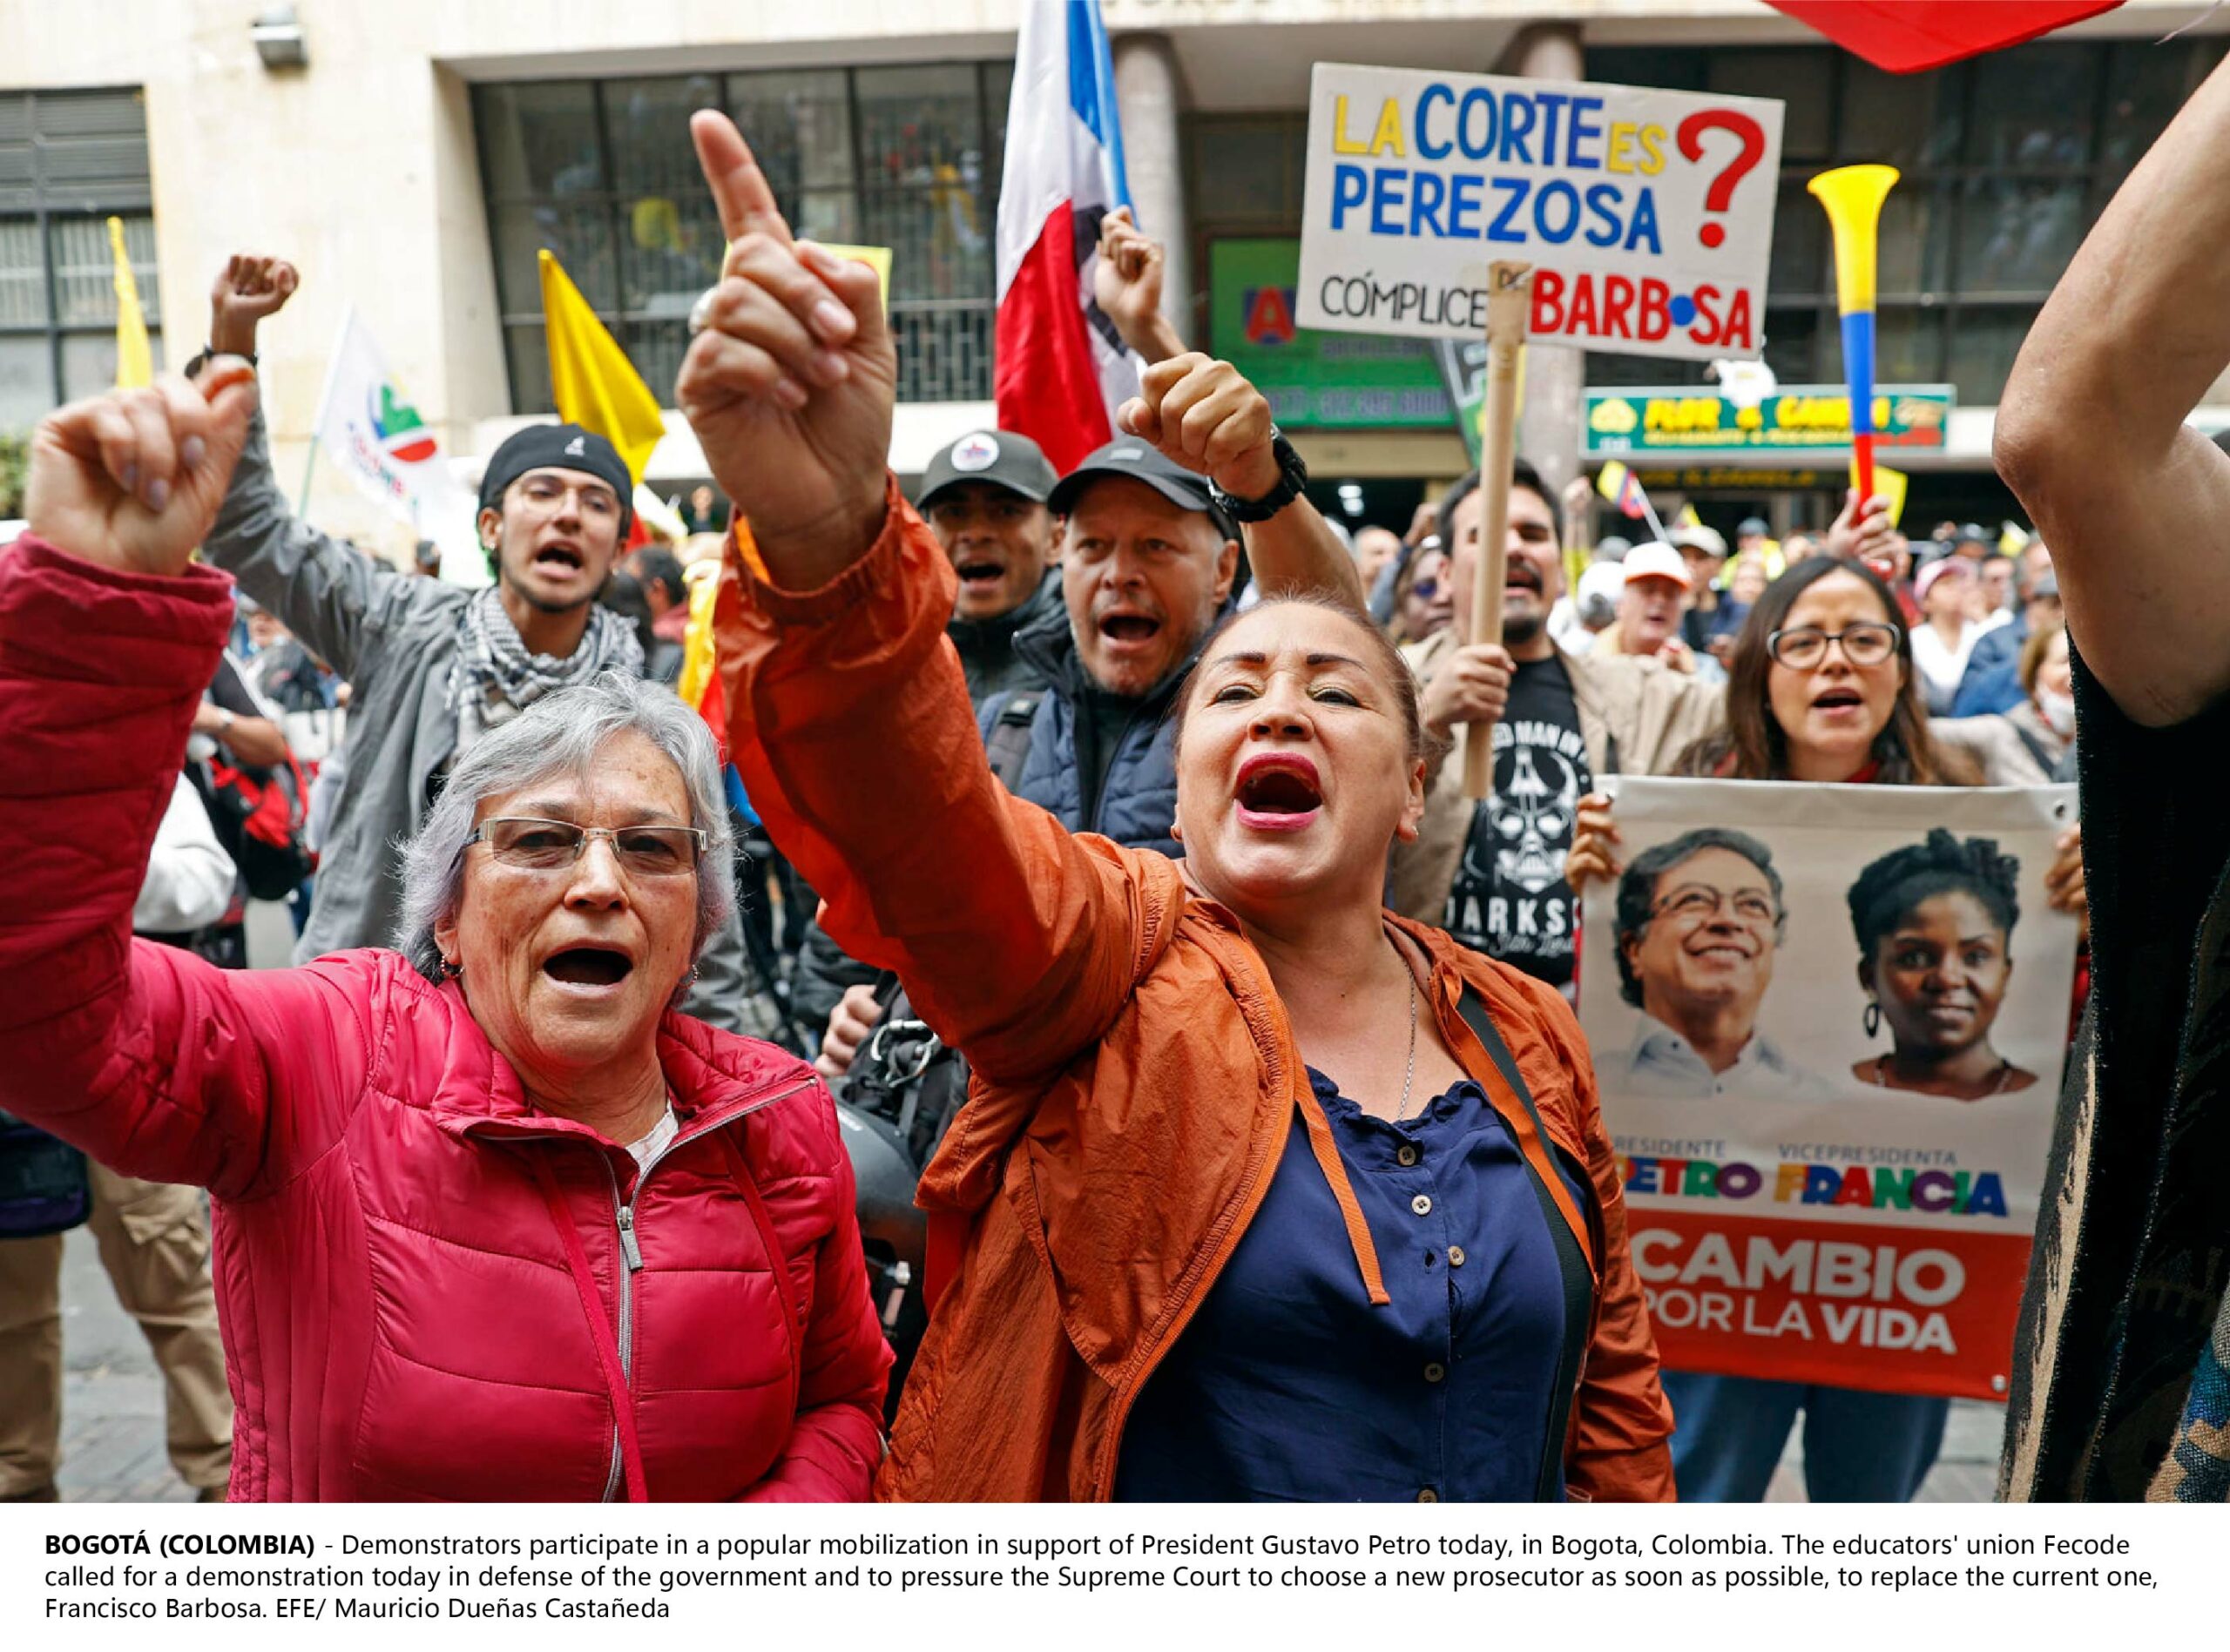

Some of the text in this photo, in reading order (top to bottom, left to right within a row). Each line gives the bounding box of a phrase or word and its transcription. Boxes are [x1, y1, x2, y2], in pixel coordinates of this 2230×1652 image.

[1332, 84, 1766, 248] LA CORTE ES ?
[1330, 164, 1663, 255] PEREZOSA
[1320, 271, 1488, 329] CÓMPLICE
[1613, 1136, 1726, 1158] RESIDENTE
[1779, 1143, 1957, 1166] VICEPRESIDENTA
[1773, 1163, 2009, 1217] FRANCIA
[1630, 1227, 1966, 1306] CAMBIO
[1743, 1296, 1813, 1339] LA
[1821, 1303, 1957, 1355] VIDA
